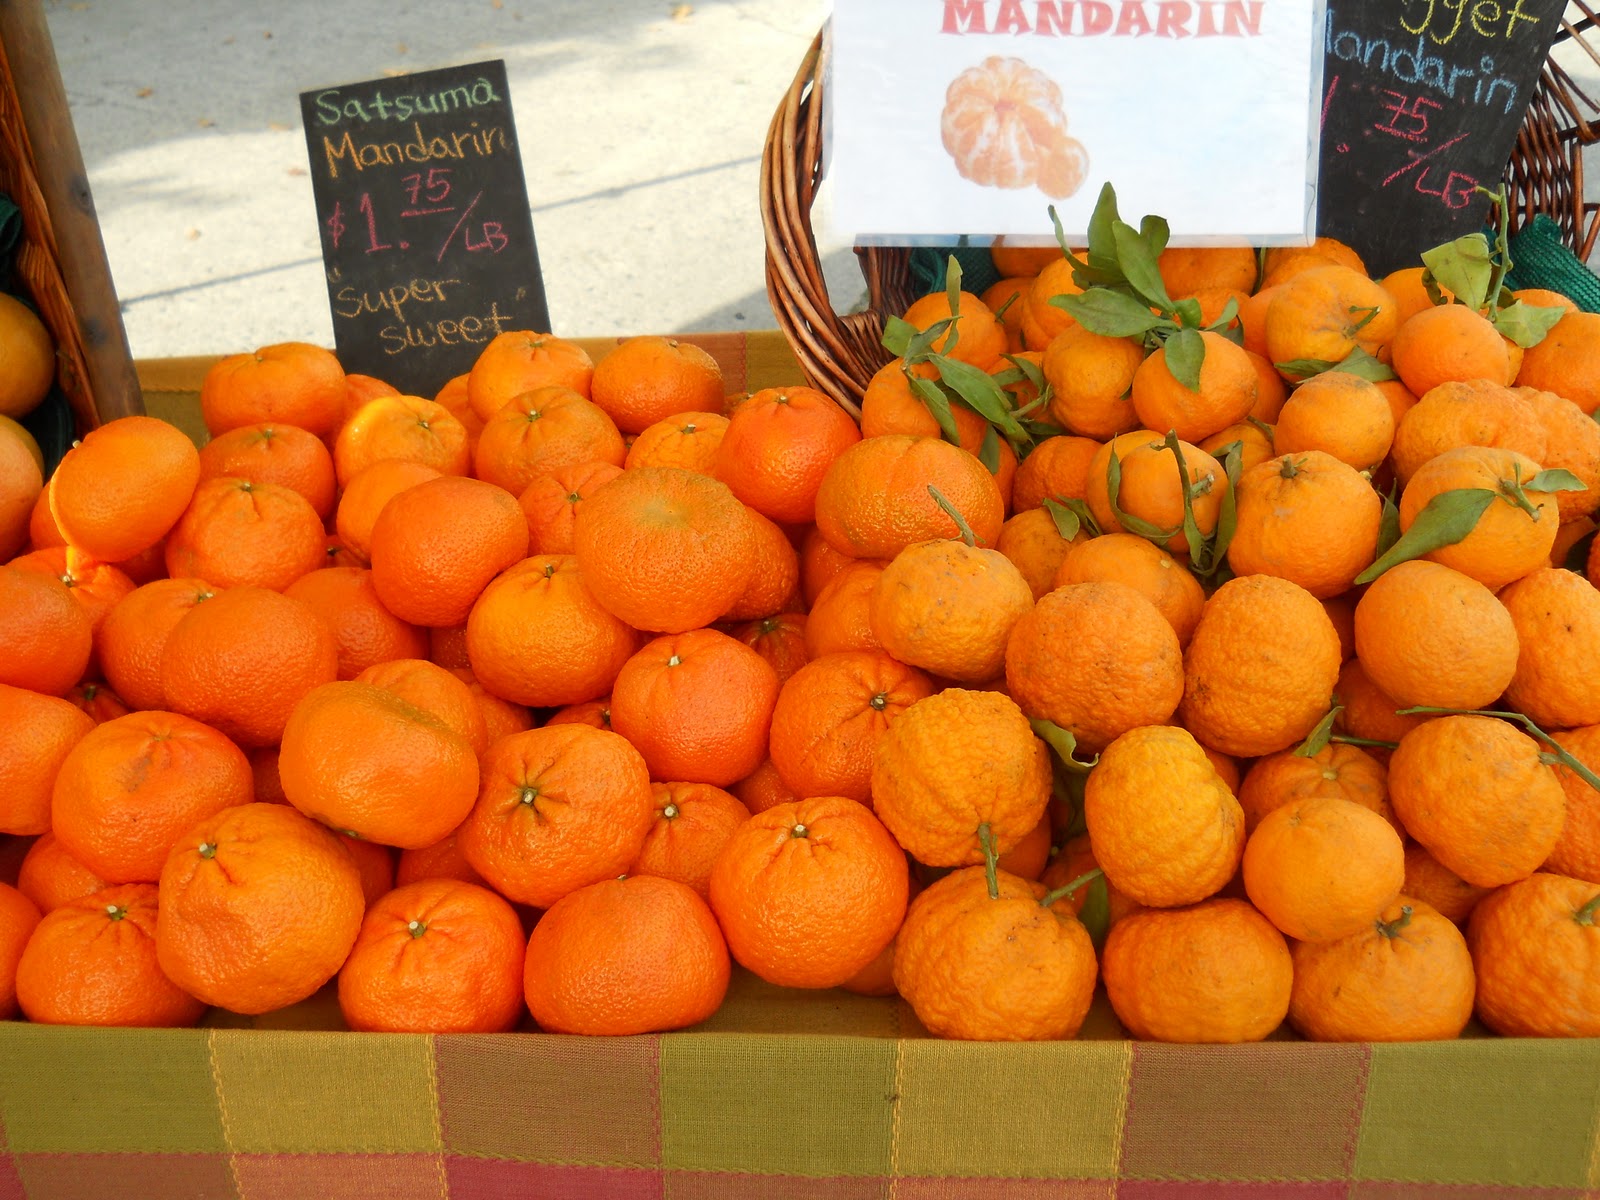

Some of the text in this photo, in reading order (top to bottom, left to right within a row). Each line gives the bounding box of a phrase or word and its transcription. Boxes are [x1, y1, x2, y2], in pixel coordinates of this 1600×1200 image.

[939, 0, 1266, 39] MANDARIN
[315, 77, 501, 125] Satsuma
[323, 121, 514, 179] Mandarin
